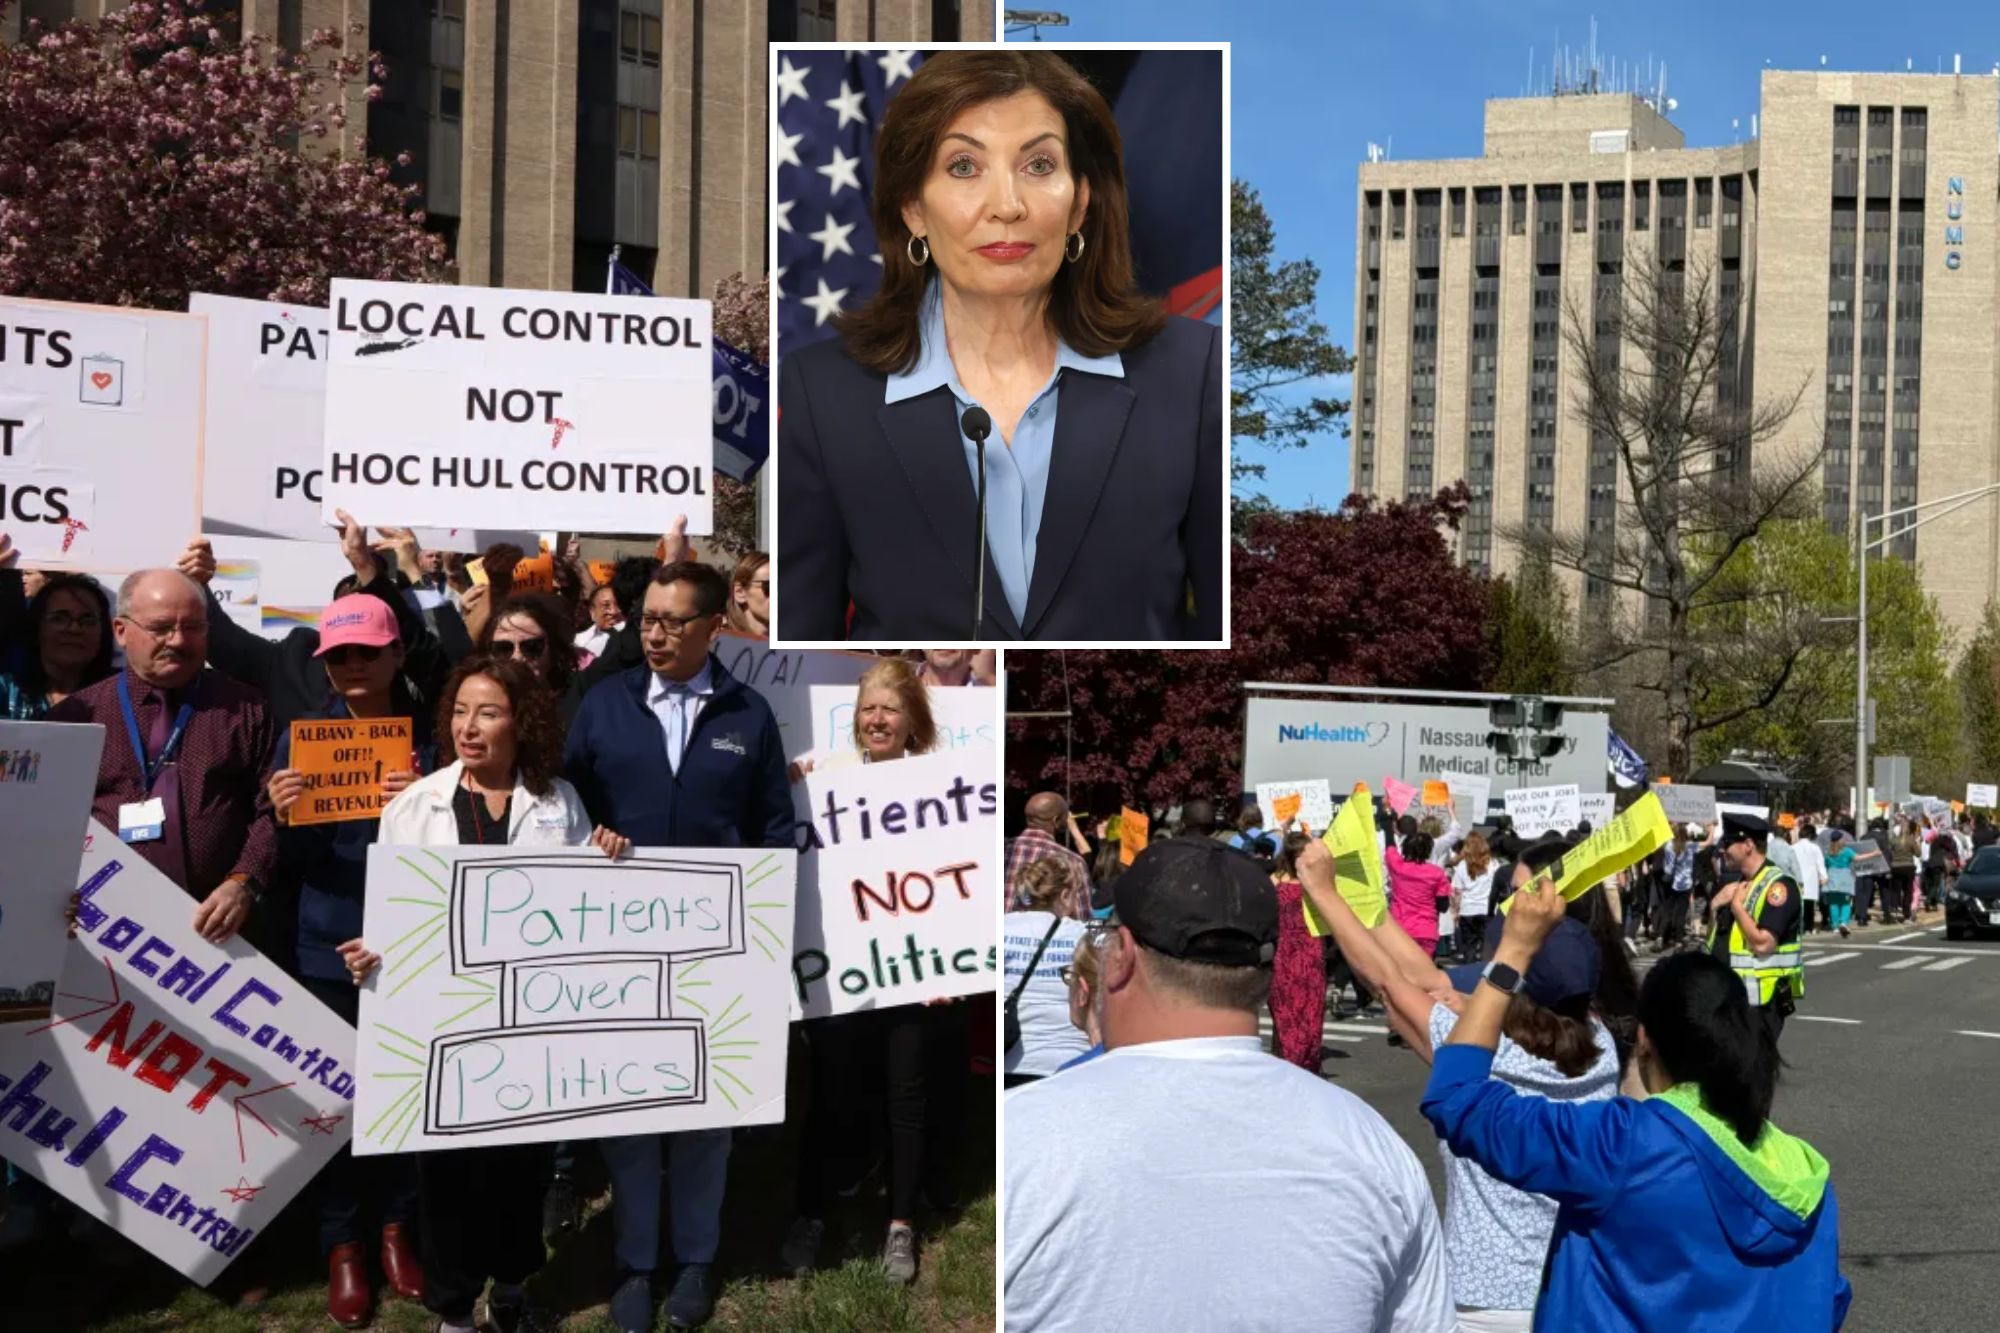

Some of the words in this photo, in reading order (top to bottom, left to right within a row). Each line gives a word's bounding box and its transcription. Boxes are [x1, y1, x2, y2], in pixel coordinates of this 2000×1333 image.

[1945, 176, 1963, 270] NUMC
[337, 297, 485, 341] LOCAL
[502, 306, 702, 348] CONTROL
[0, 324, 73, 368] TS
[466, 386, 563, 424] NOT
[520, 459, 706, 495] CONTROL
[297, 726, 355, 741] ALBANY
[369, 724, 407, 738] BACK
[1279, 722, 1366, 743] NuHealth
[1420, 727, 1486, 747] Nassau
[333, 747, 374, 762] OFF!!
[1419, 755, 1489, 775] Medical
[1495, 758, 1552, 777] Ceter
[303, 771, 371, 790] QUALITY
[1507, 793, 1528, 801] SAVE
[1531, 791, 1550, 799] OUR
[1555, 788, 1576, 797] JOBS
[481, 867, 722, 947] Patients
[852, 862, 979, 921] NOT
[522, 969, 652, 1014] Over
[85, 1001, 251, 1114] NOT
[445, 1040, 693, 1123] Politics
[0, 1061, 128, 1168] hul
